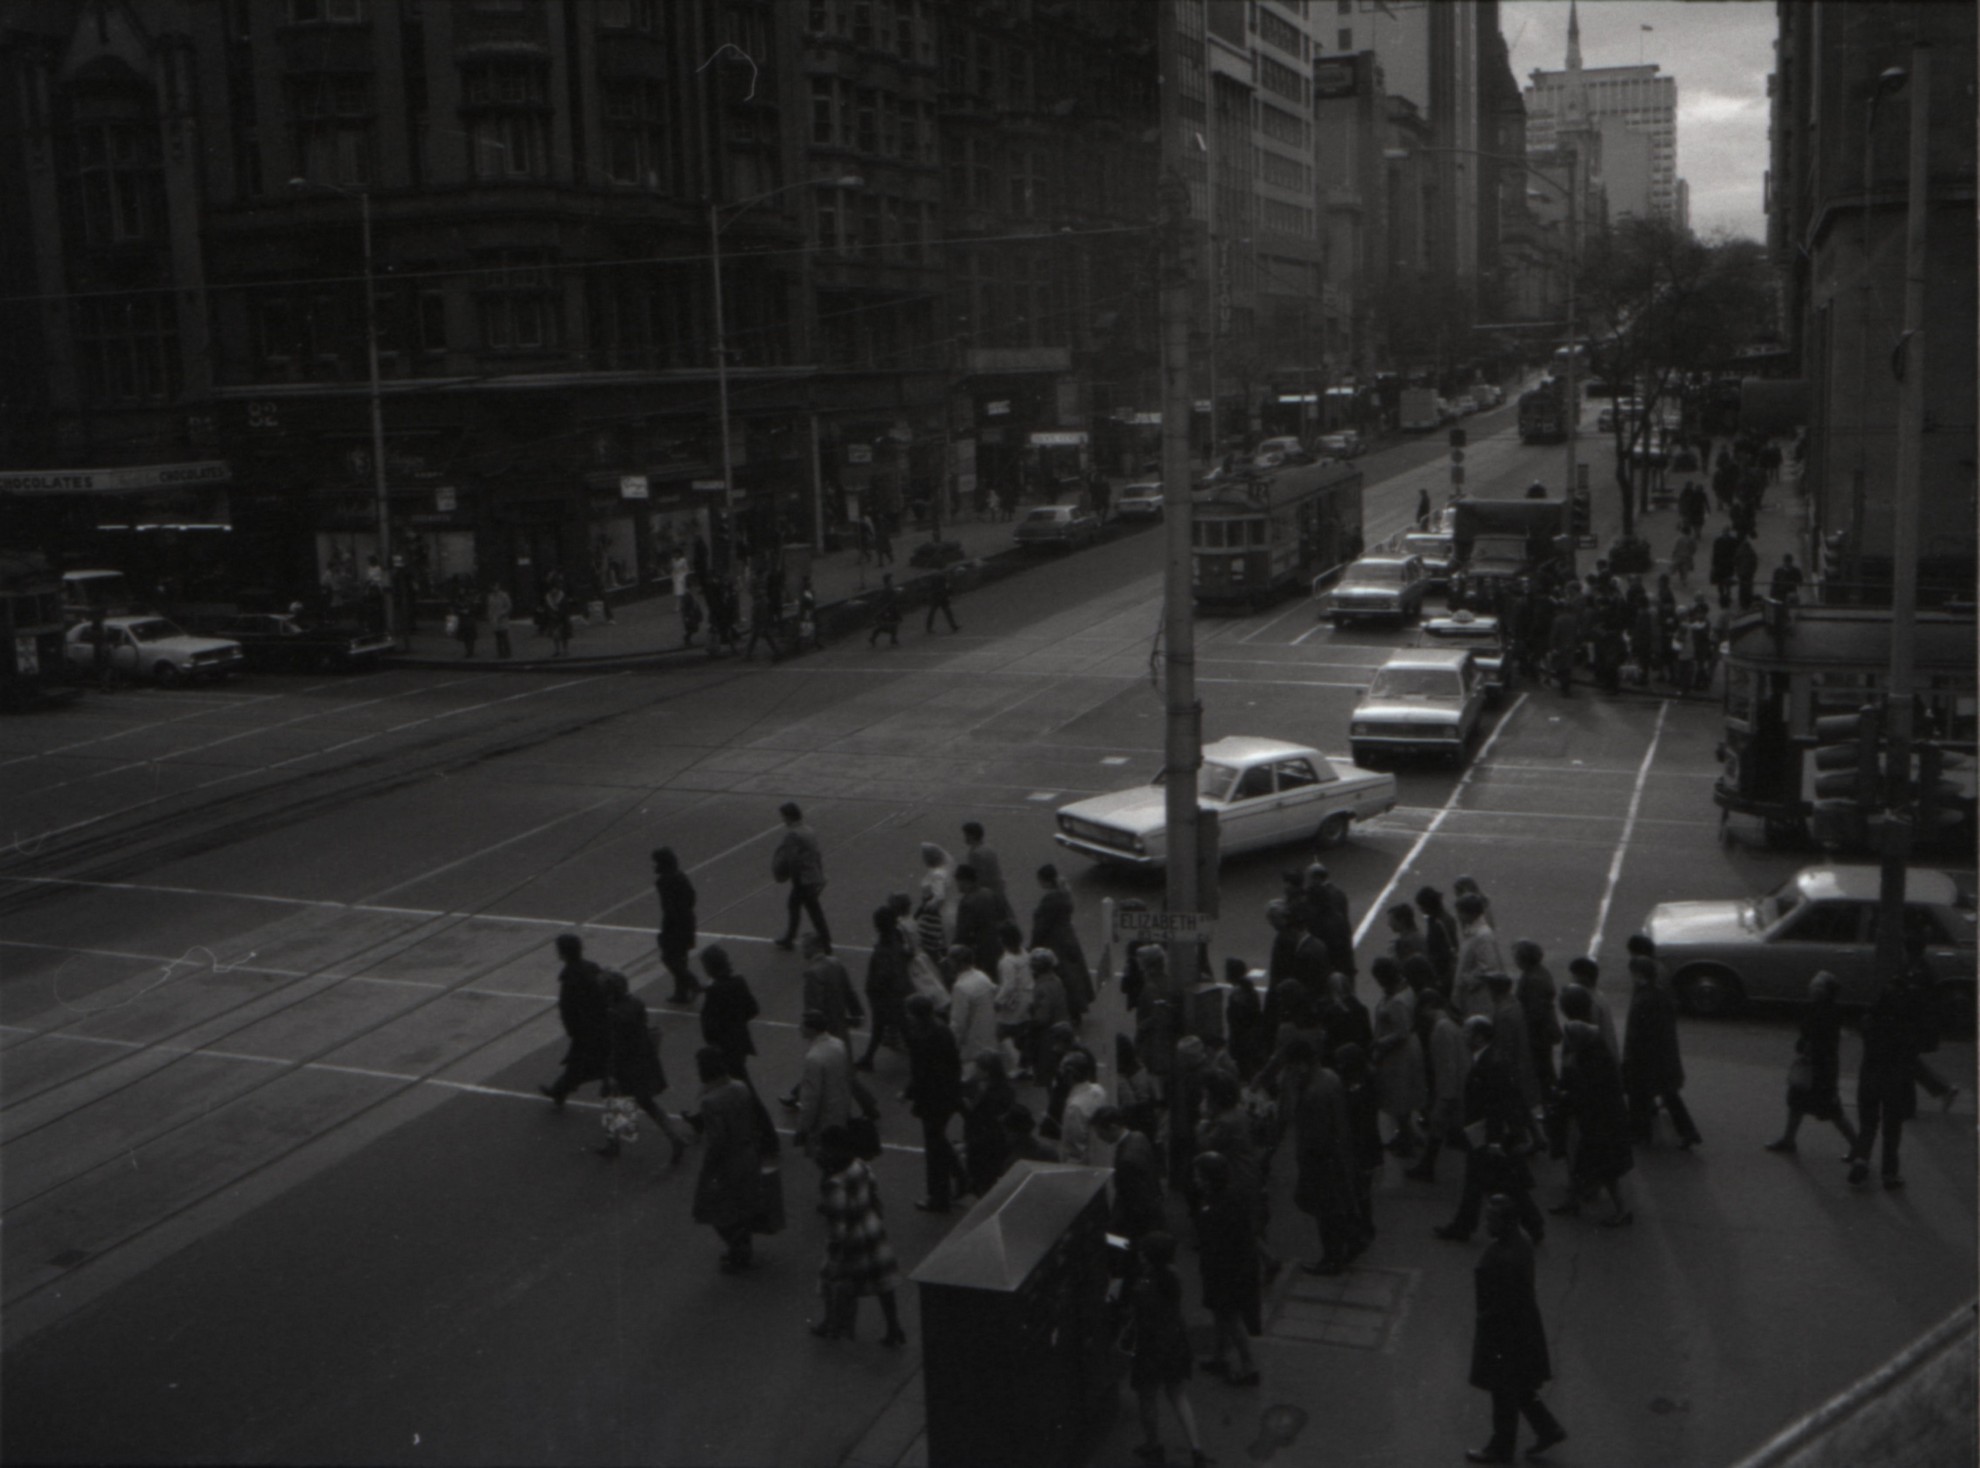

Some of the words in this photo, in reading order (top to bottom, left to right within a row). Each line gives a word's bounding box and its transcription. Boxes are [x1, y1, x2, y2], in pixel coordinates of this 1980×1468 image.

[248, 402, 279, 427] 82
[159, 466, 225, 484] CHOCOLATES
[1120, 912, 1197, 931] ELIZABETH
